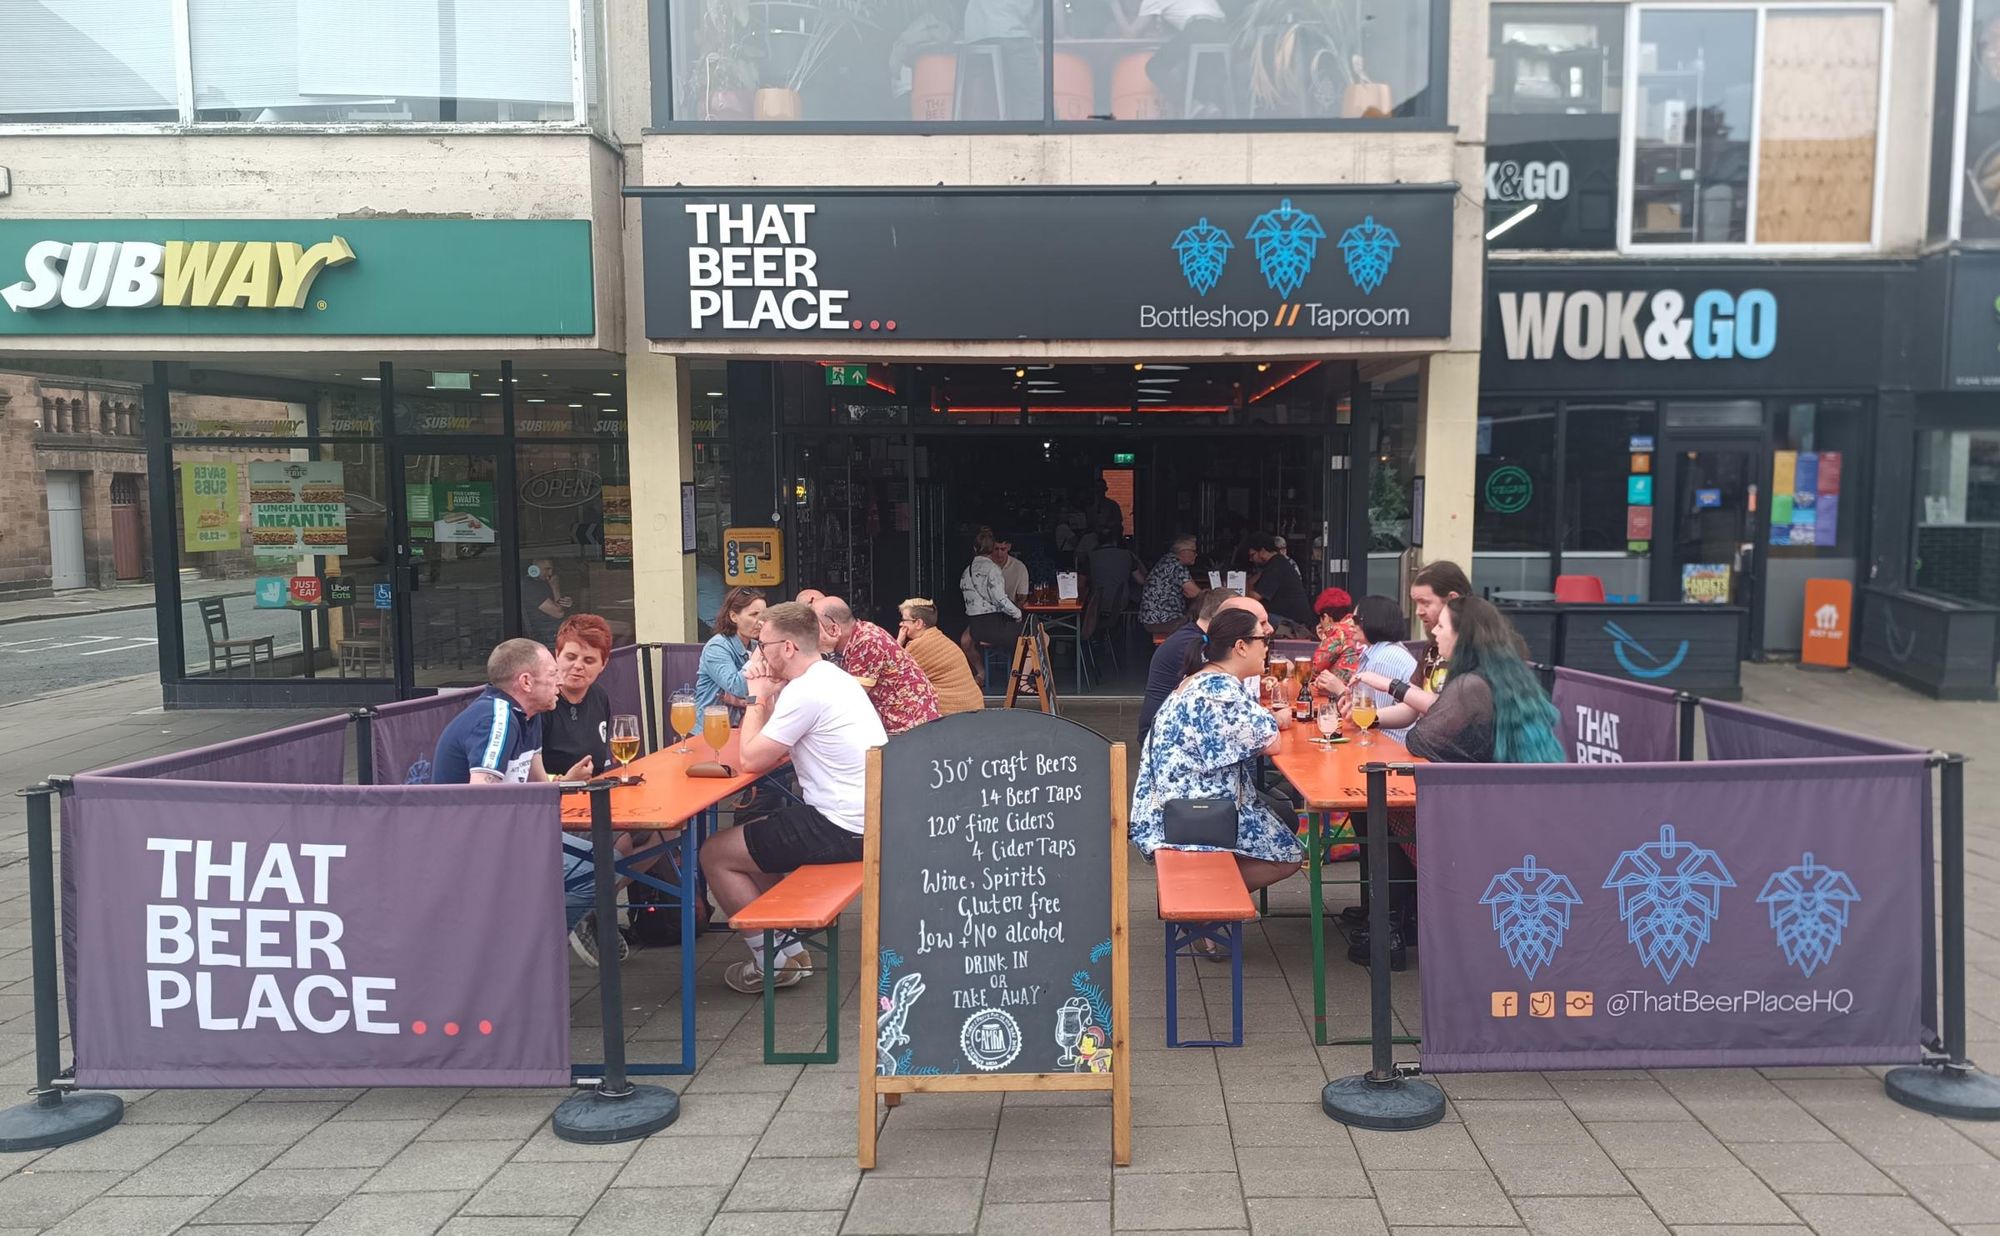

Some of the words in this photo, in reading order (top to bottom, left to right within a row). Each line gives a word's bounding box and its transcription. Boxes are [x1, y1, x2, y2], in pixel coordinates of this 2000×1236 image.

[686, 203, 816, 246] THAT
[0, 235, 356, 312] SUBWAY
[688, 247, 818, 288] BEER
[1140, 303, 1269, 334] Bottleshop
[1305, 302, 1410, 331] Taproom
[1499, 289, 1778, 360] WOK&GO
[327, 419, 379, 432] SUBWAY
[422, 416, 473, 429] SUBWAY
[517, 420, 570, 432] SUBWAY
[531, 478, 592, 498] OPEN
[258, 504, 294, 513] LUNCH
[294, 504, 317, 512] LIKE
[317, 504, 339, 512] YOU
[258, 513, 317, 527] MEAN
[318, 513, 340, 527] IT.
[294, 581, 316, 590] JUST
[299, 588, 316, 596] EAT
[331, 584, 350, 592] Uber
[332, 591, 351, 599] Eats
[1576, 704, 1620, 750] THAT
[1036, 753, 1077, 777] Beers
[981, 788, 1002, 808] 14
[1006, 786, 1040, 807] Beer
[1046, 784, 1082, 805] Taps
[965, 813, 999, 842] fine
[1006, 812, 1055, 833] Ciders
[972, 841, 984, 861] 4
[992, 839, 1034, 861] Cider
[1035, 837, 1077, 857] Taps
[146, 837, 346, 904] THAT
[921, 869, 975, 894] Wine,
[983, 865, 1046, 891] Spirits
[958, 893, 1023, 936] Gluten
[1029, 891, 1061, 919] free
[146, 904, 346, 970] BEER
[917, 919, 953, 955] Low
[974, 923, 997, 948] No
[1005, 921, 1065, 944] alcohol
[964, 953, 1008, 975] DRINK
[1012, 950, 1029, 969] IN
[990, 974, 1008, 989] OR
[953, 989, 987, 1009] TAKE
[1000, 986, 1041, 1008] AWAY
[1606, 988, 1854, 1018] @ThatBeerPlaceHQ
[974, 1029, 1006, 1050] CAMRA
